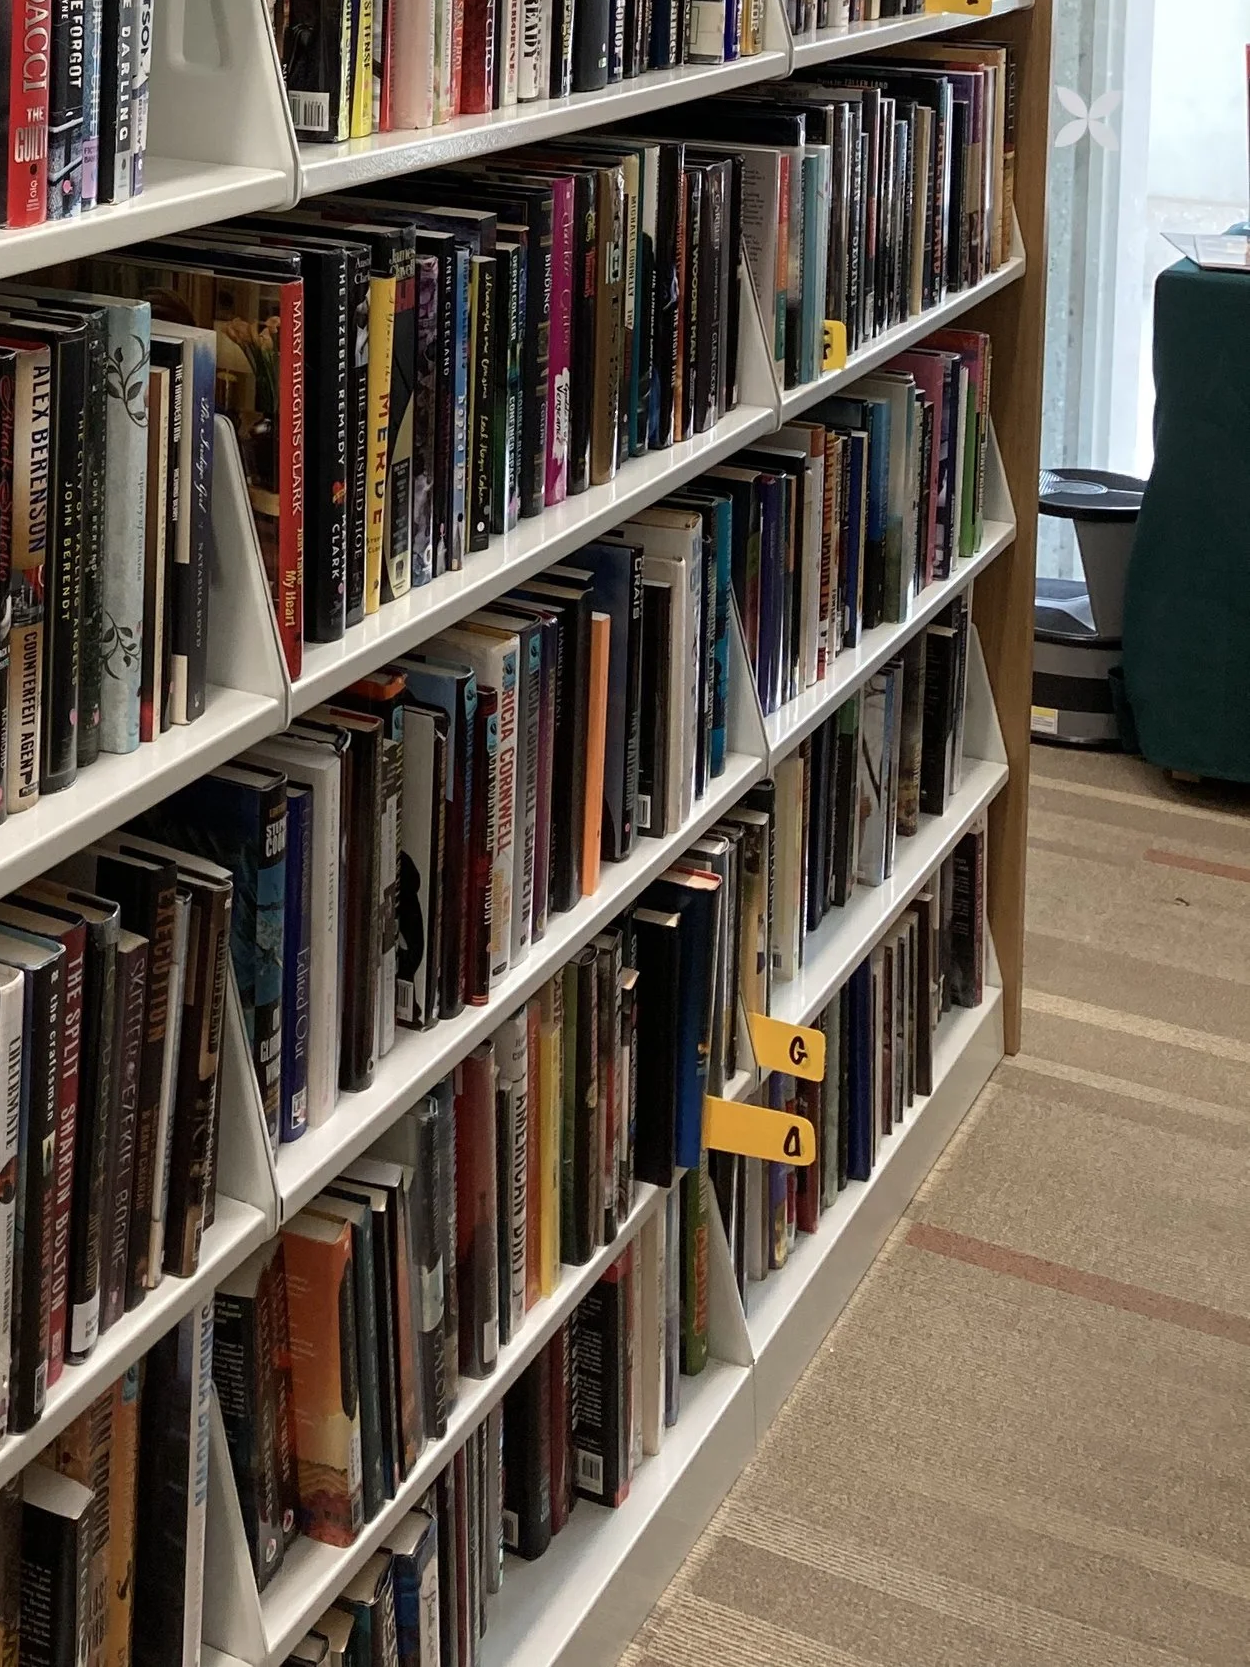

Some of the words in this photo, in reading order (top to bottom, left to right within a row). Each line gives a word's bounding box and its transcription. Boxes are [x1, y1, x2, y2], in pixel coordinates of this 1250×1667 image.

[485, 17, 495, 73] CHO
[445, 254, 453, 293] ANNE
[543, 253, 553, 315] BINDING
[627, 237, 637, 299] CONNELLY
[27, 428, 50, 555] BERENSON
[372, 391, 392, 529] MERDE
[633, 553, 644, 622] CRAIS
[495, 744, 516, 857] CORNWELL
[62, 1005, 83, 1082] SPLIT
[788, 1035, 809, 1066] G
[56, 1094, 78, 1188] SHARON
[50, 1202, 73, 1314] BOLTON
